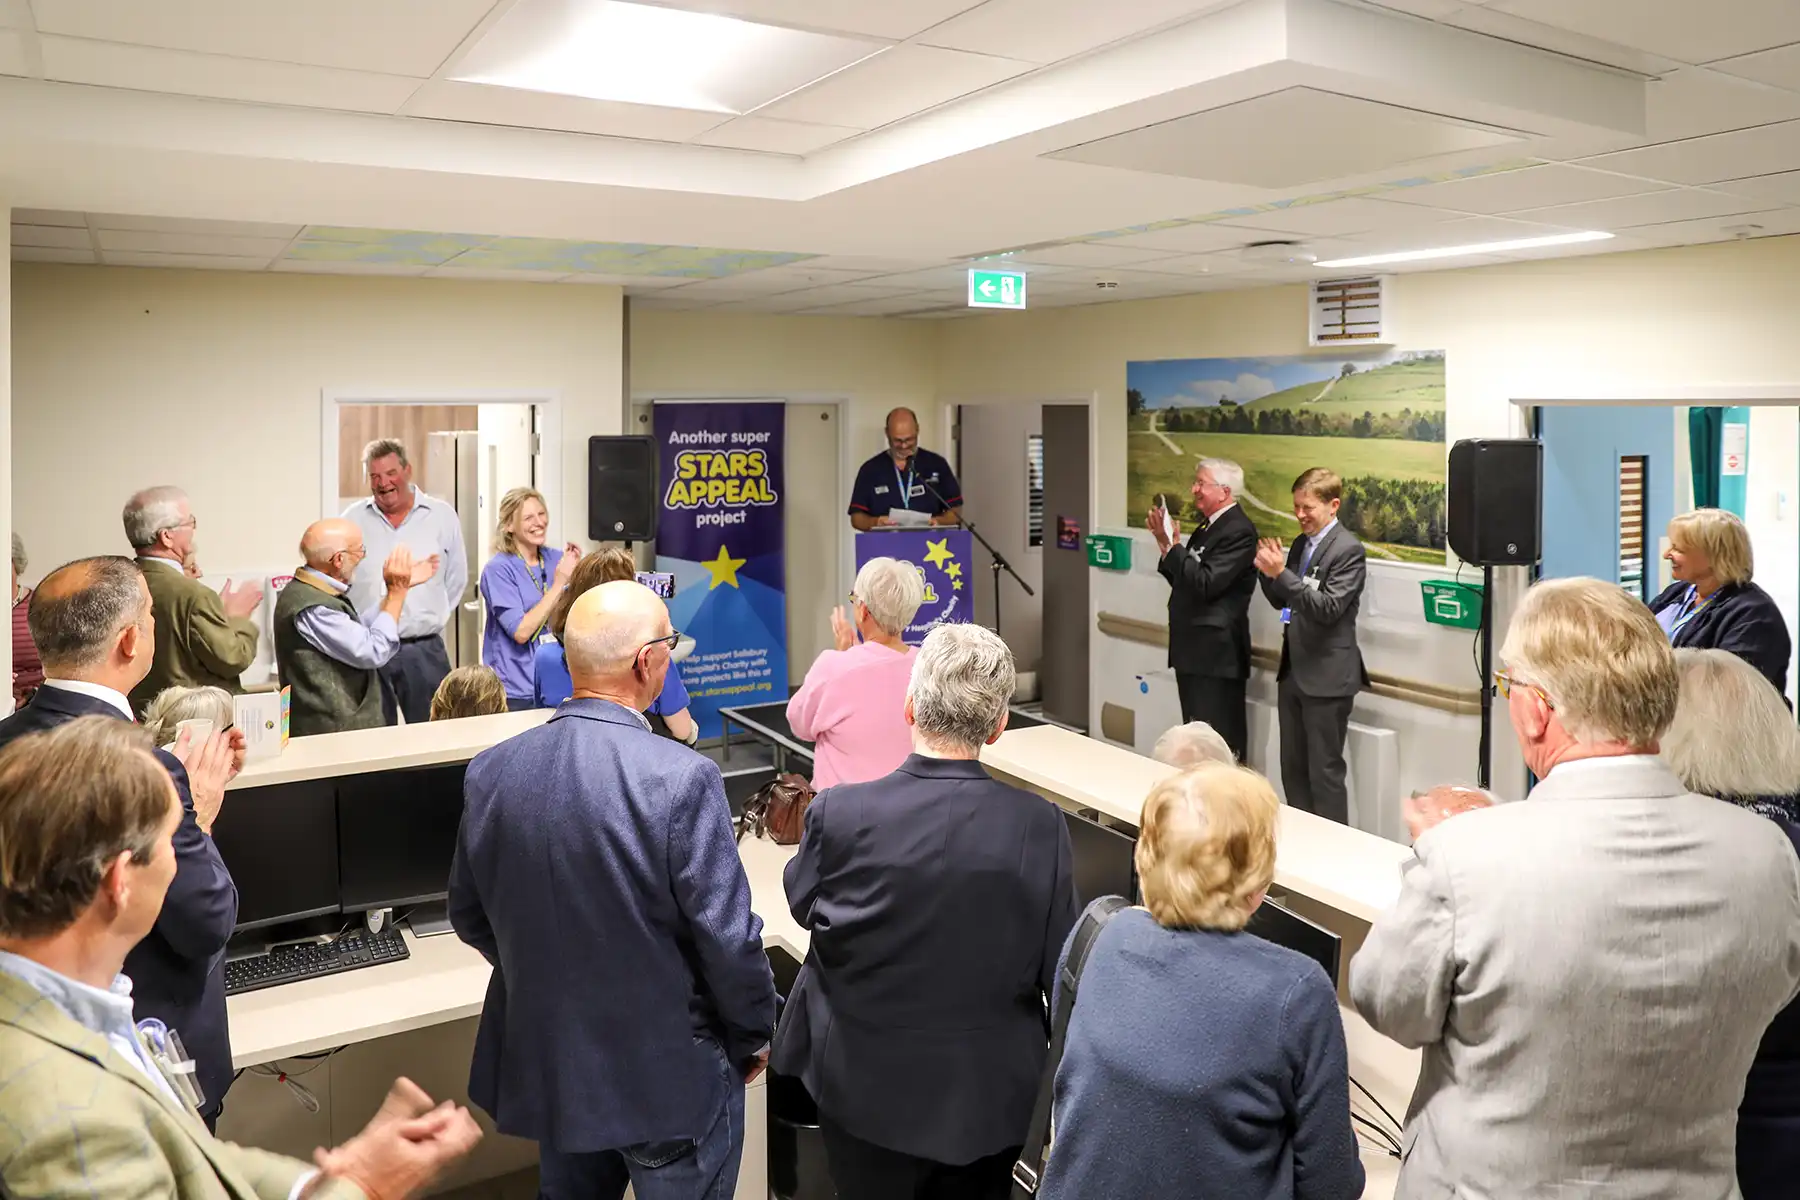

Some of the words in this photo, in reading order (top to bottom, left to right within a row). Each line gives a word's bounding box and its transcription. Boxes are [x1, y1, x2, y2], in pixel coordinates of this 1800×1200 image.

[669, 430, 727, 444] Another
[731, 431, 770, 445] super
[677, 451, 766, 479] STARS
[666, 479, 776, 507] APPEAL
[696, 510, 747, 528] project
[703, 651, 731, 662] support
[733, 649, 768, 658] Salisbury
[722, 660, 750, 670] Charity
[750, 657, 767, 667] with
[701, 673, 731, 684] projects
[733, 671, 746, 679] like
[748, 669, 761, 677] this
[763, 668, 771, 676] at
[688, 682, 772, 697] ww.starsappeal.org
